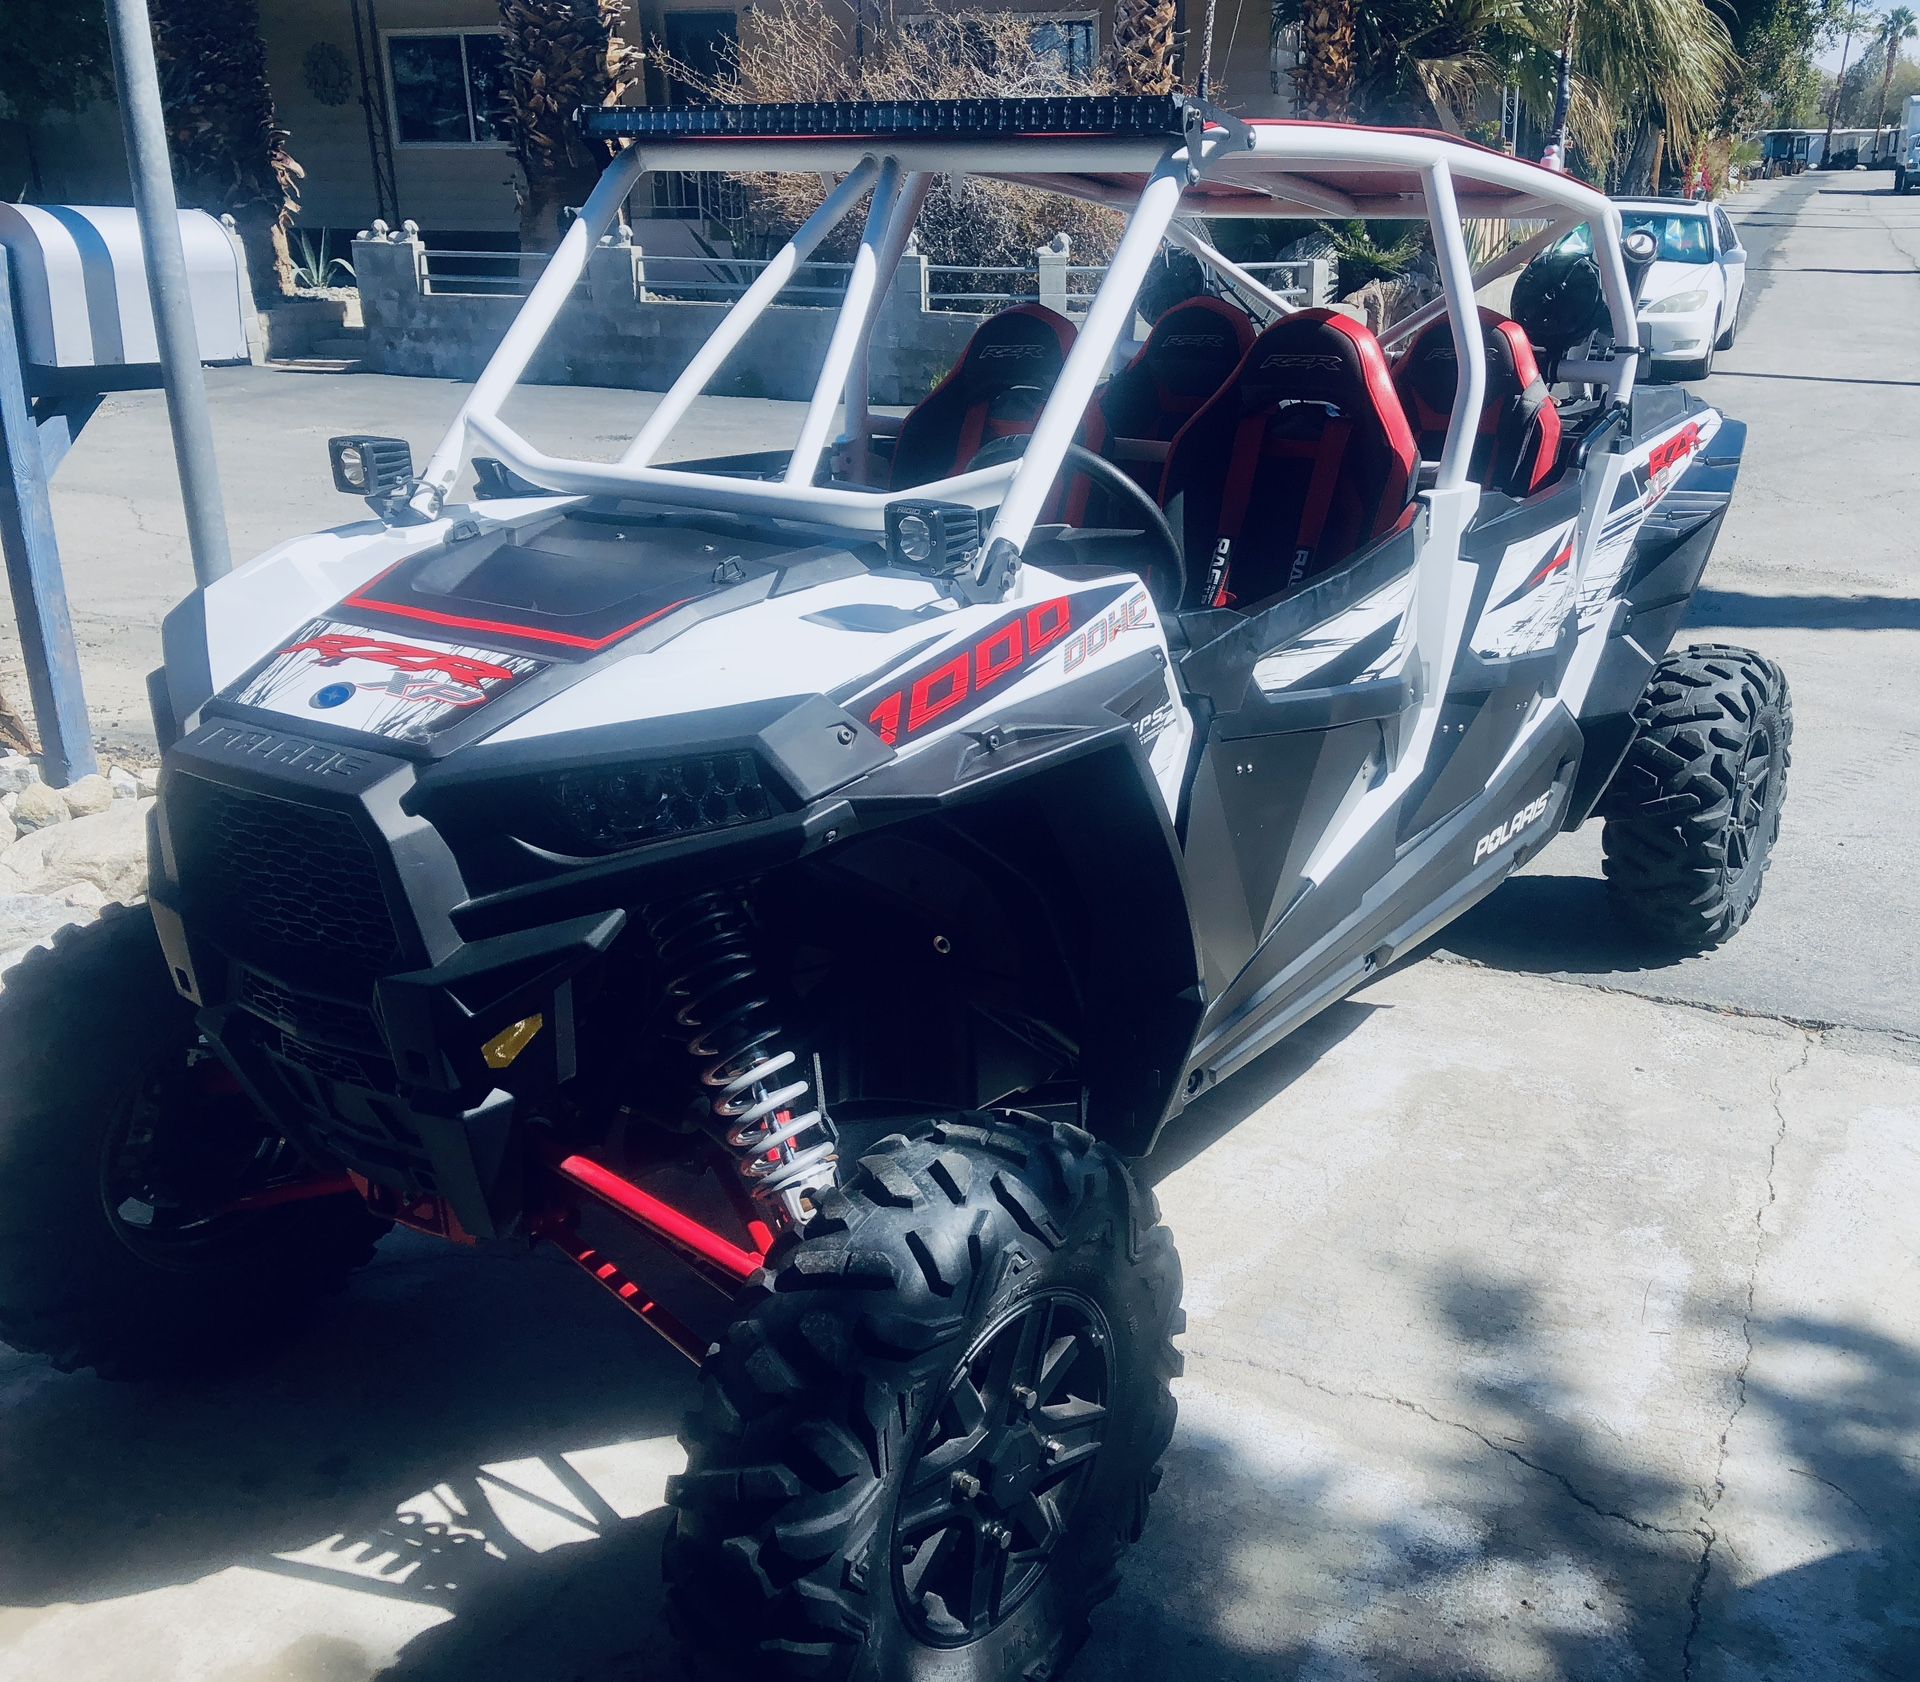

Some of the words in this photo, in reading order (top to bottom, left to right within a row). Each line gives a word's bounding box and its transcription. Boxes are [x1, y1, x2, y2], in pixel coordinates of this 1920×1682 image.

[979, 345, 1045, 359] RZR
[1260, 354, 1343, 371] RZR
[896, 507, 921, 516] RIGID
[1063, 591, 1155, 674] DOHC
[277, 633, 513, 690] RZR
[869, 595, 1072, 746] 1000
[355, 671, 489, 706] XP
[199, 726, 373, 776] POLARIS
[1472, 790, 1552, 866] POLARIS
